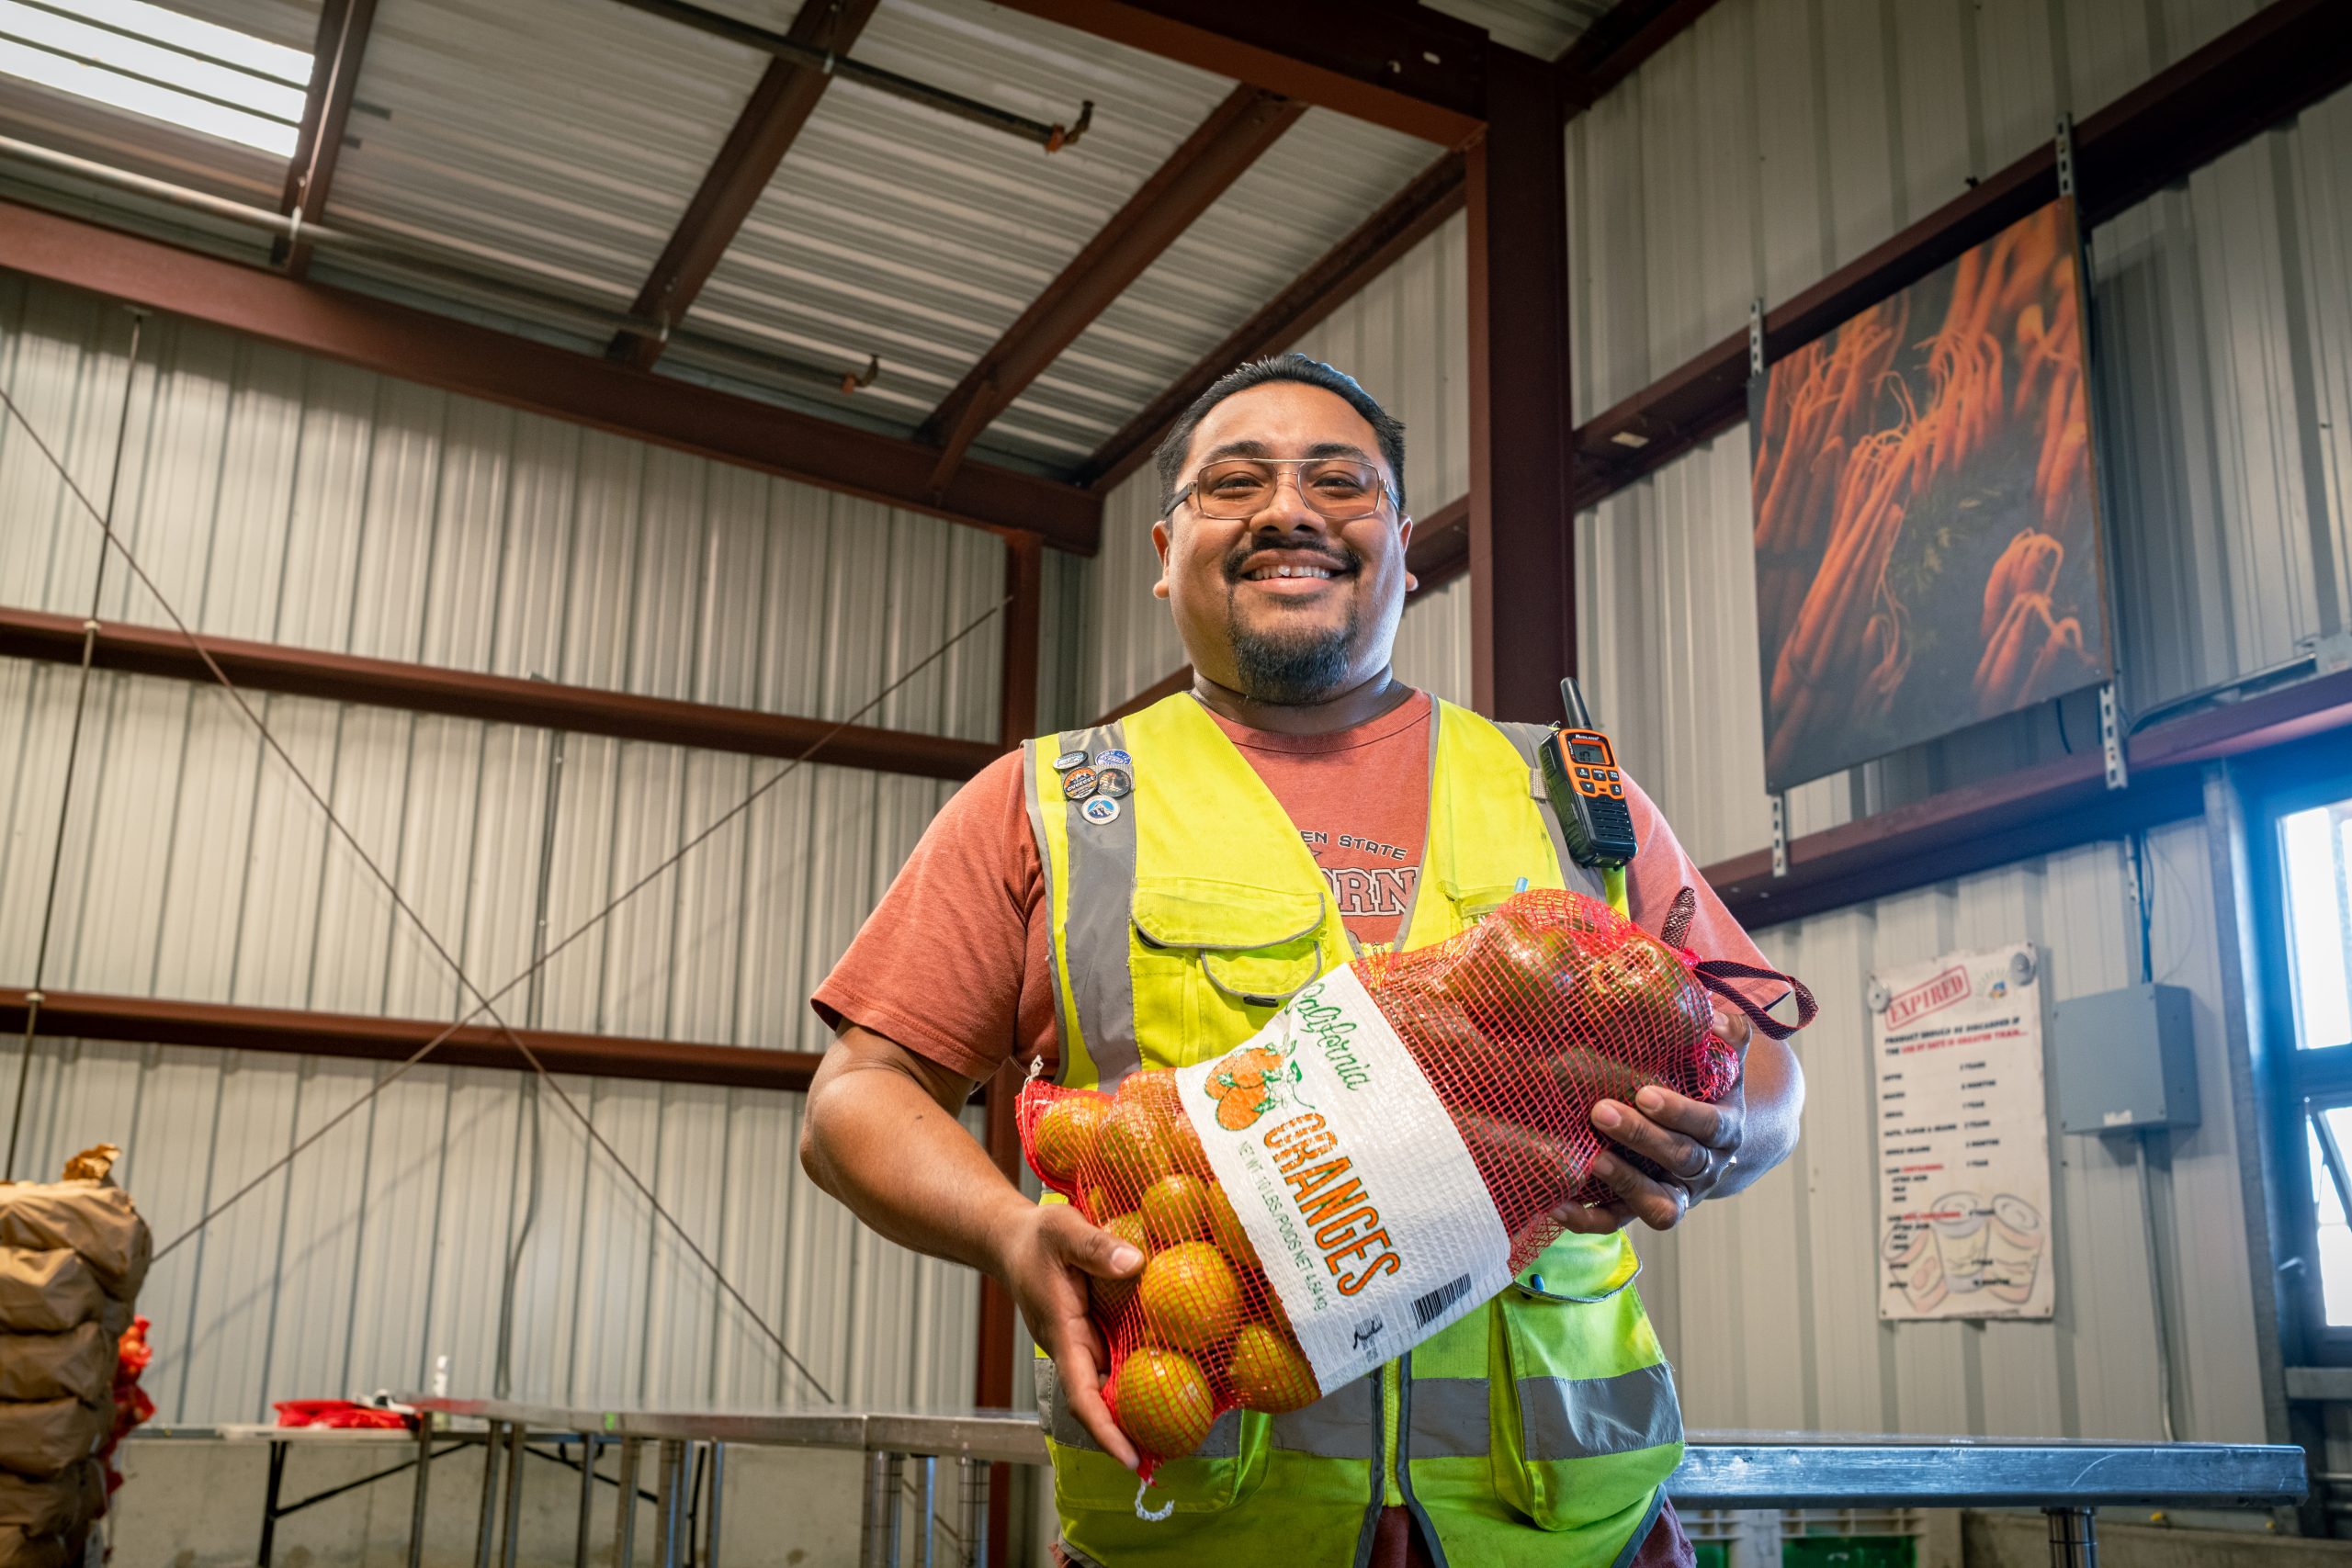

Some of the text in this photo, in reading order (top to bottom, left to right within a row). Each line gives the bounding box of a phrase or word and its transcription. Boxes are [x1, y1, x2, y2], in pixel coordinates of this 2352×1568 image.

[1067, 775, 1095, 792] everest
[1338, 835, 1408, 861] STATE
[1888, 975, 1964, 1023] EXPIRED
[1284, 982, 1370, 1091] California
[1263, 1111, 1401, 1296] ORANGES
[1293, 1249, 1313, 1272] NET
